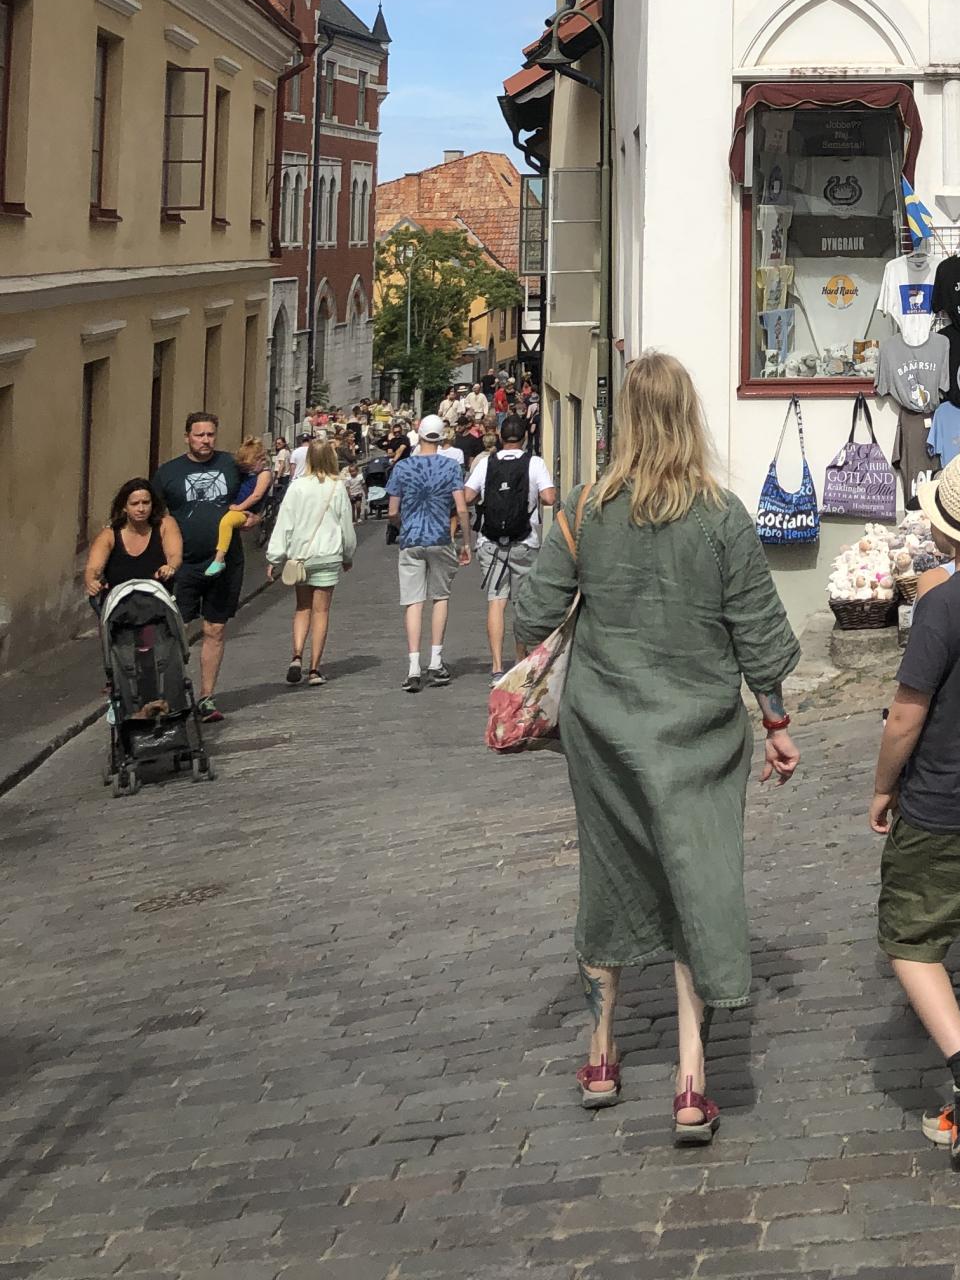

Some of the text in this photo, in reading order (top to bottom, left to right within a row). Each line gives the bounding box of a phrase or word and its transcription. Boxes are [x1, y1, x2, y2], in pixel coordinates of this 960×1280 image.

[821, 237, 865, 251] DYNGRAUK
[821, 286, 839, 295] Hard
[827, 470, 894, 485] GOTLAND
[756, 509, 815, 529] Gotland
